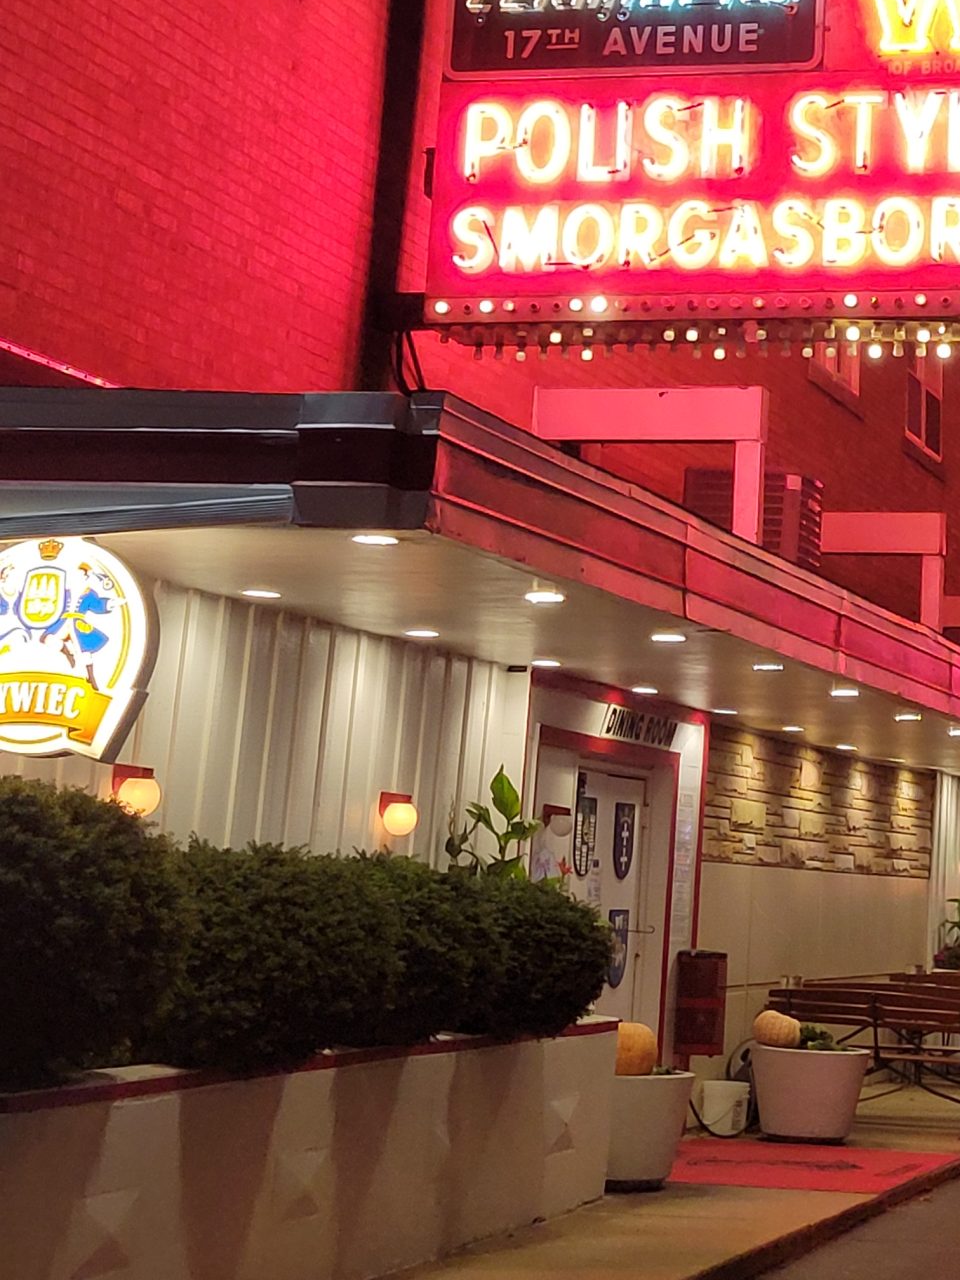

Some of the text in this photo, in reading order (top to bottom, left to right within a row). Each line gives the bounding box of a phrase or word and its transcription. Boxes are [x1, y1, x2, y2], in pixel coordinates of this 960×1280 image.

[504, 22, 762, 59] 17TH AVENUE
[463, 92, 751, 183] POLISH
[605, 708, 678, 747] DINING ROOM
